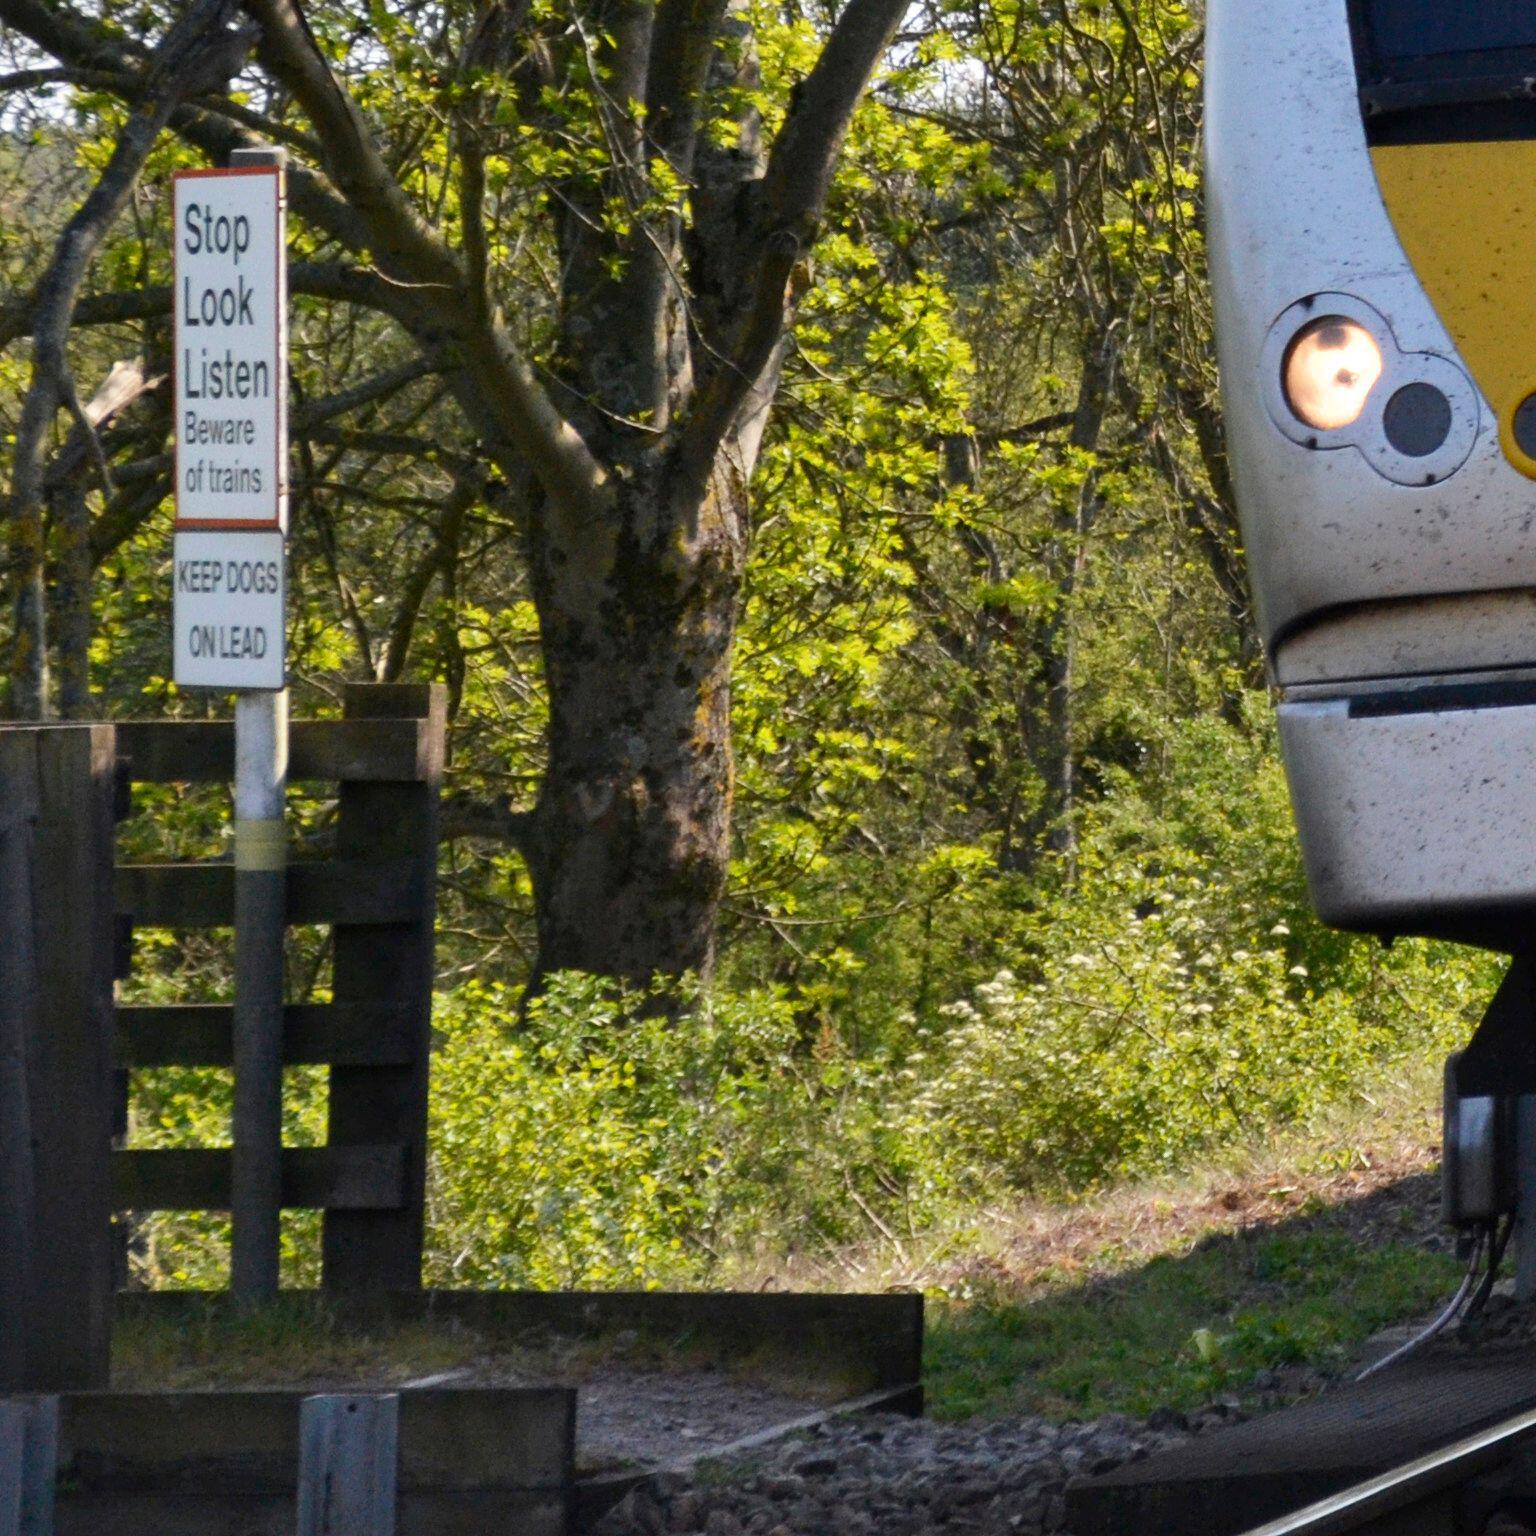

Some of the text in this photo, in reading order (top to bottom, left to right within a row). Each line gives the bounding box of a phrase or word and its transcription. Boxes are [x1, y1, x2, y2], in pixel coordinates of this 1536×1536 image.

[184, 203, 250, 265] Stop
[184, 275, 254, 327] Look
[185, 348, 269, 399] Listen
[185, 411, 255, 445] Beware
[186, 459, 262, 494] of trains
[178, 560, 279, 594] KEEP DOGS
[189, 625, 267, 659] ON LEAD
